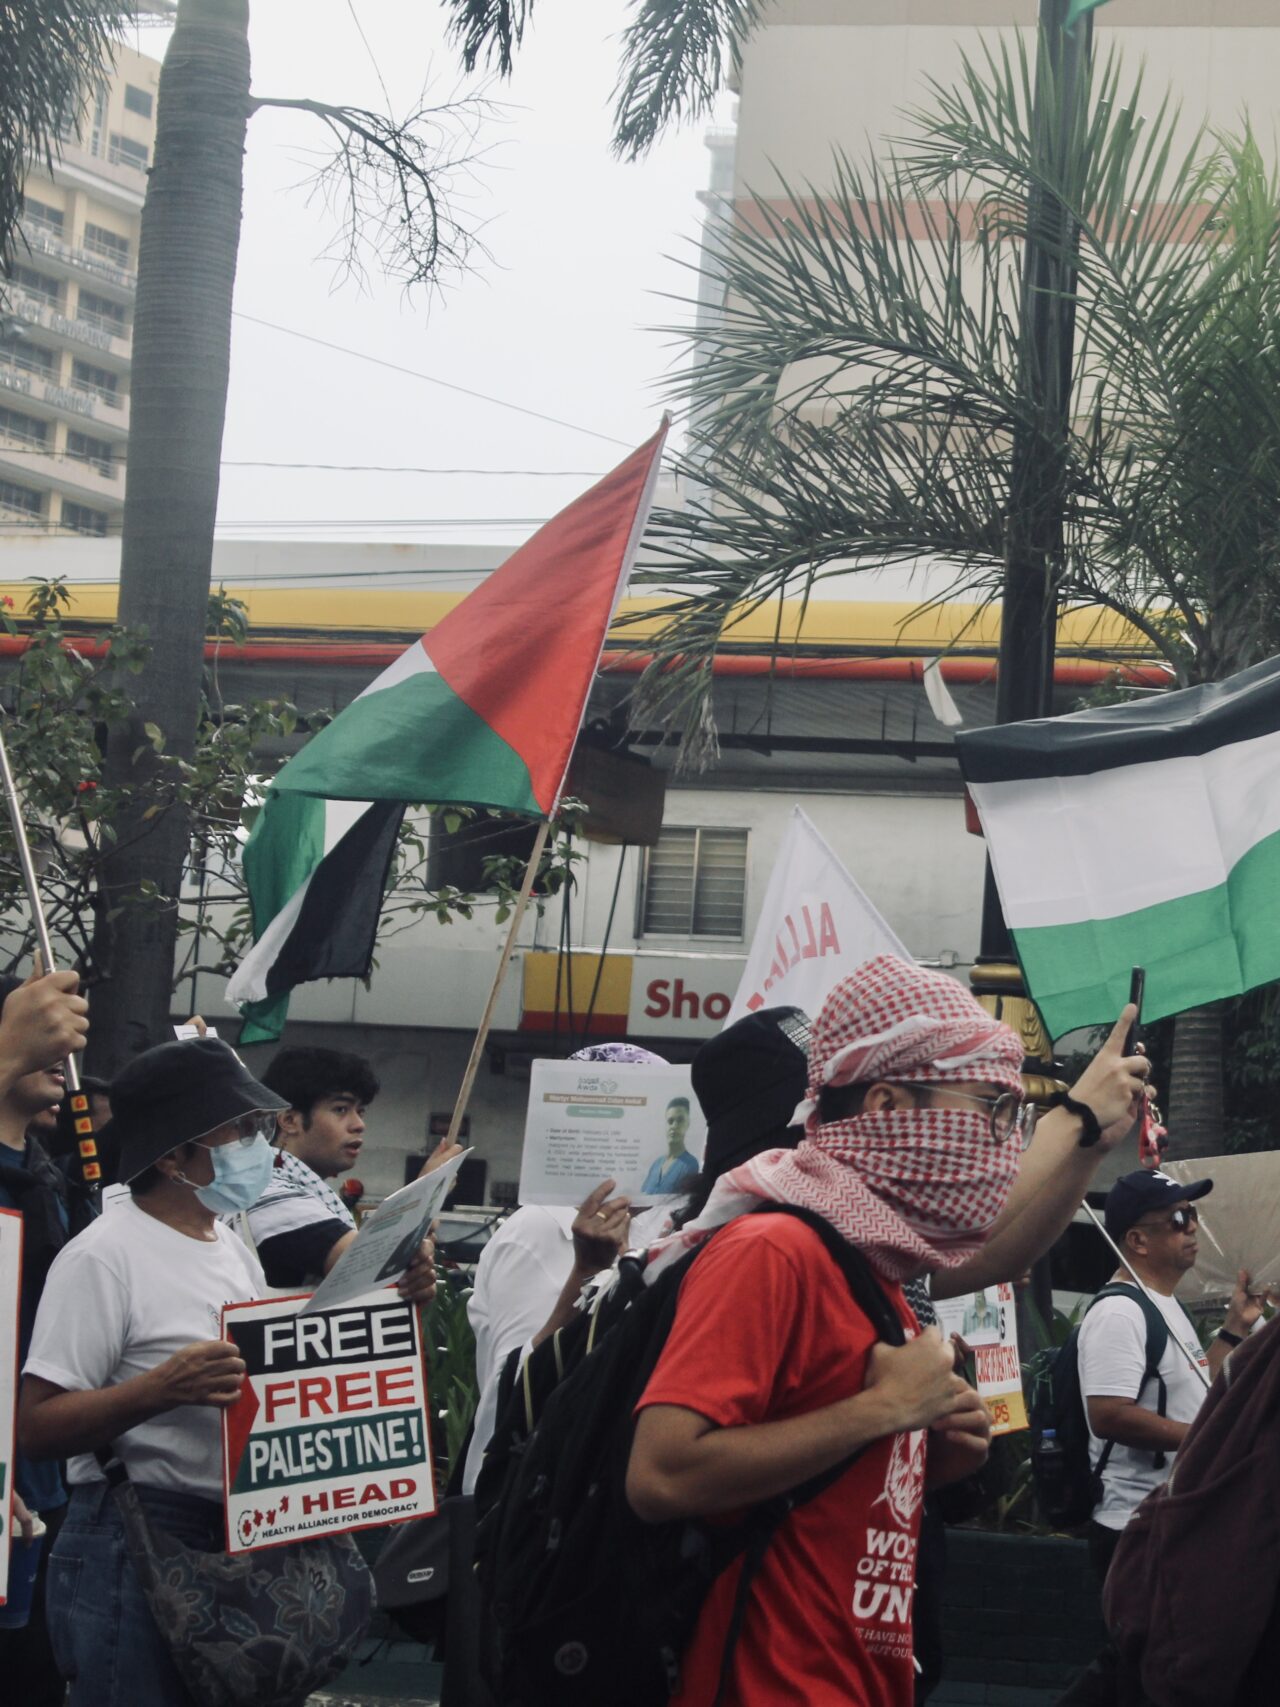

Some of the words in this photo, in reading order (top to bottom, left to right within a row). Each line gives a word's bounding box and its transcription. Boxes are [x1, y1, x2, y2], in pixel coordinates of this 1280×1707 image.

[643, 978, 732, 1020] Sho
[263, 1307, 412, 1366] FREE
[264, 1366, 415, 1423] FREE
[249, 1416, 422, 1483] PALESTINE!
[302, 1478, 417, 1515] HEAD
[262, 1524, 296, 1539] HEALTH
[297, 1516, 339, 1531] ALLIANCE
[341, 1512, 360, 1524] FOR
[361, 1502, 419, 1519] DEMOCRACY
[856, 1557, 890, 1578] OF
[864, 1629, 896, 1643] HAVE
